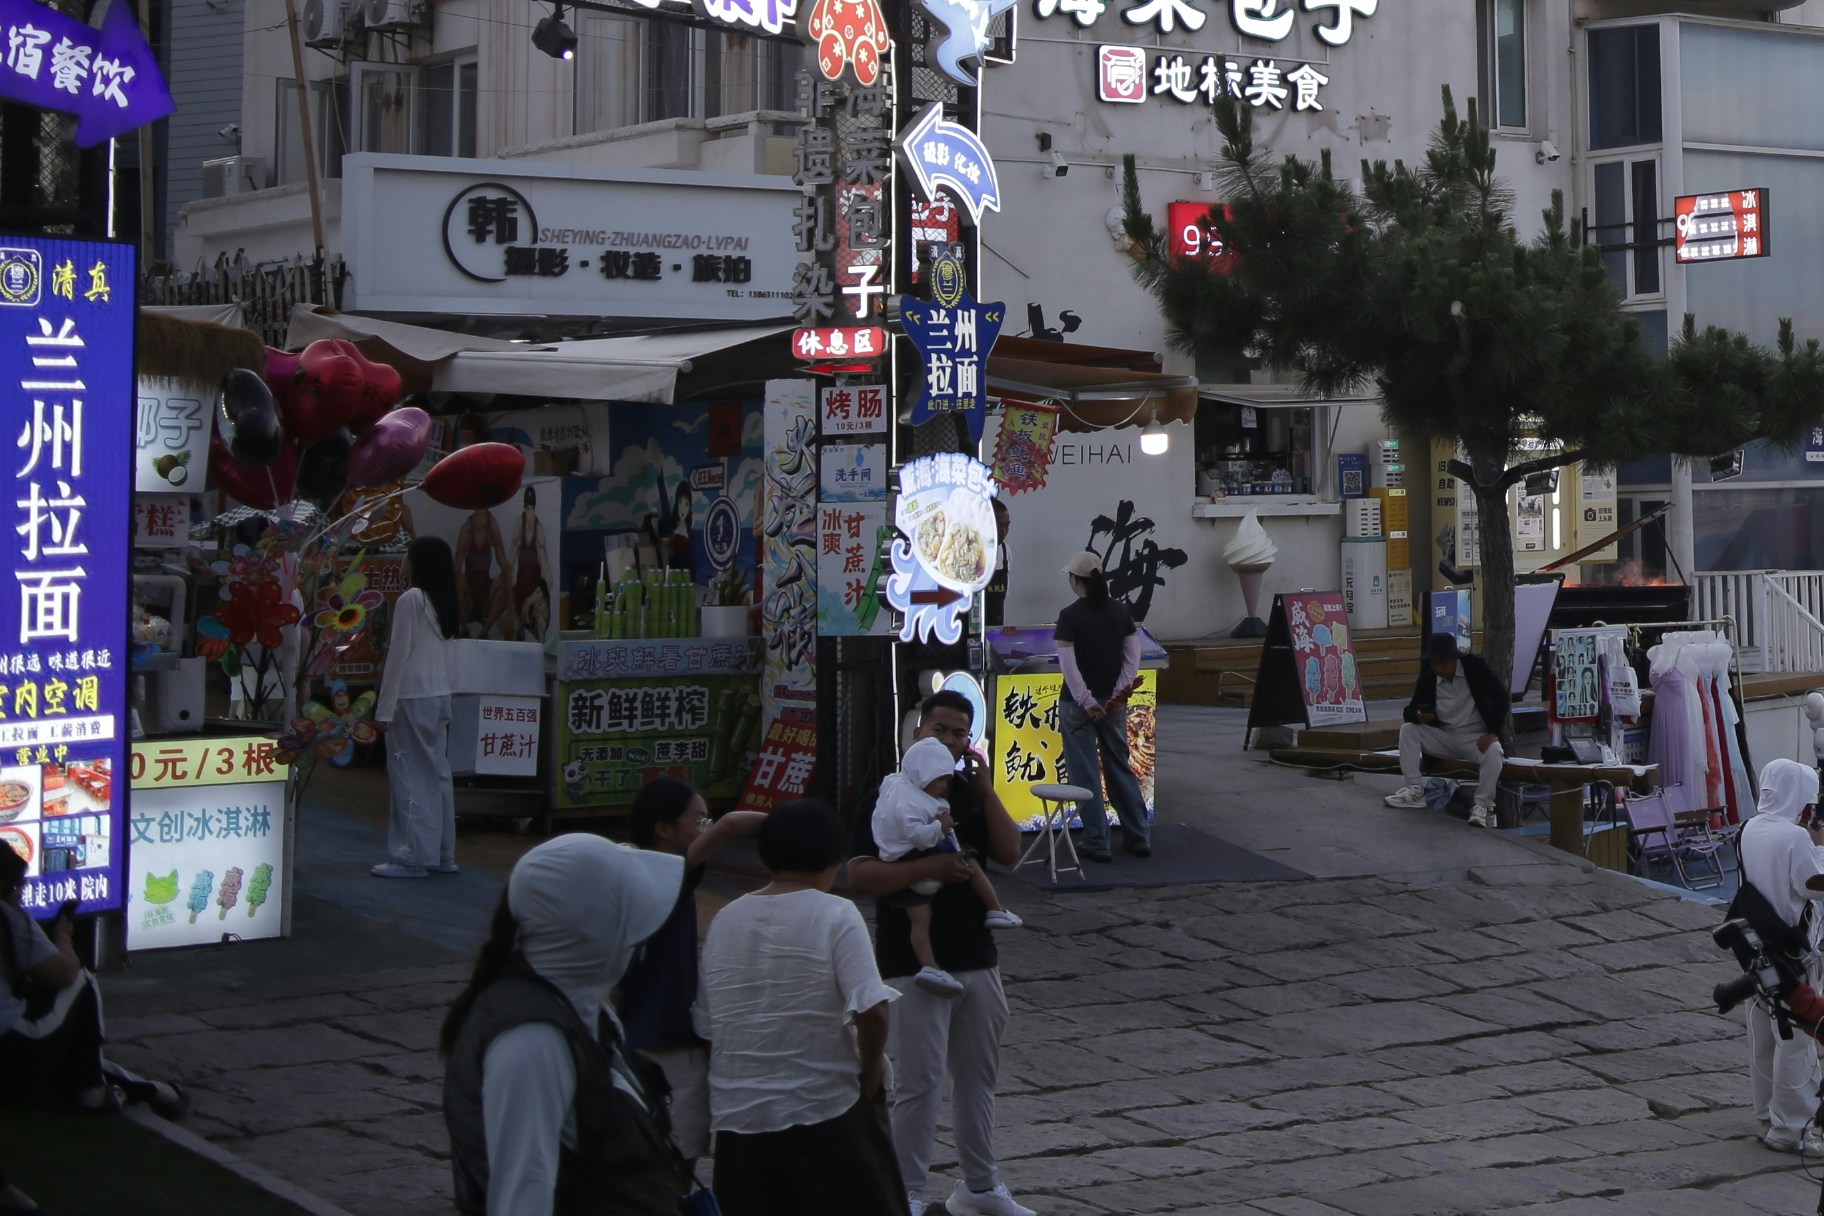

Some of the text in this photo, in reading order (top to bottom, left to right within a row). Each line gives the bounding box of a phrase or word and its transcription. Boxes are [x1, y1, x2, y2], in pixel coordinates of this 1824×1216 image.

[0, 24, 135, 108] 宿餐饮
[1153, 54, 1329, 112] 地标美食
[923, 141, 949, 166] 摄影
[468, 196, 518, 245] 韩
[1742, 191, 1758, 256] 冰淇淋
[51, 260, 112, 303] 清真
[797, 329, 875, 356] 休息区
[927, 309, 978, 353] 兰州
[927, 353, 978, 399] 拉面
[826, 389, 882, 420] 烤肠
[836, 421, 873, 430] 10元/3根
[1007, 412, 1038, 478] 铁板鱿鱼
[15, 317, 88, 643] 兰州拉面
[835, 468, 871, 482] 洗手间
[823, 508, 842, 555] 冰爽
[339, 565, 411, 593] 士热
[843, 512, 866, 606] 甘蔗汁
[49, 648, 112, 672] 味道很近
[577, 643, 756, 672] 冰爽解暑甘蔗汁
[482, 706, 537, 723] 世界五百强
[571, 686, 707, 730] 新鲜鲜榨
[16, 744, 69, 766] 营业中
[480, 733, 537, 758] 甘蔗汁
[582, 746, 623, 761] 无添加
[753, 746, 816, 795] 甘蔗
[131, 805, 271, 845] 文创冰淇淋
[81, 874, 108, 901] 院内
